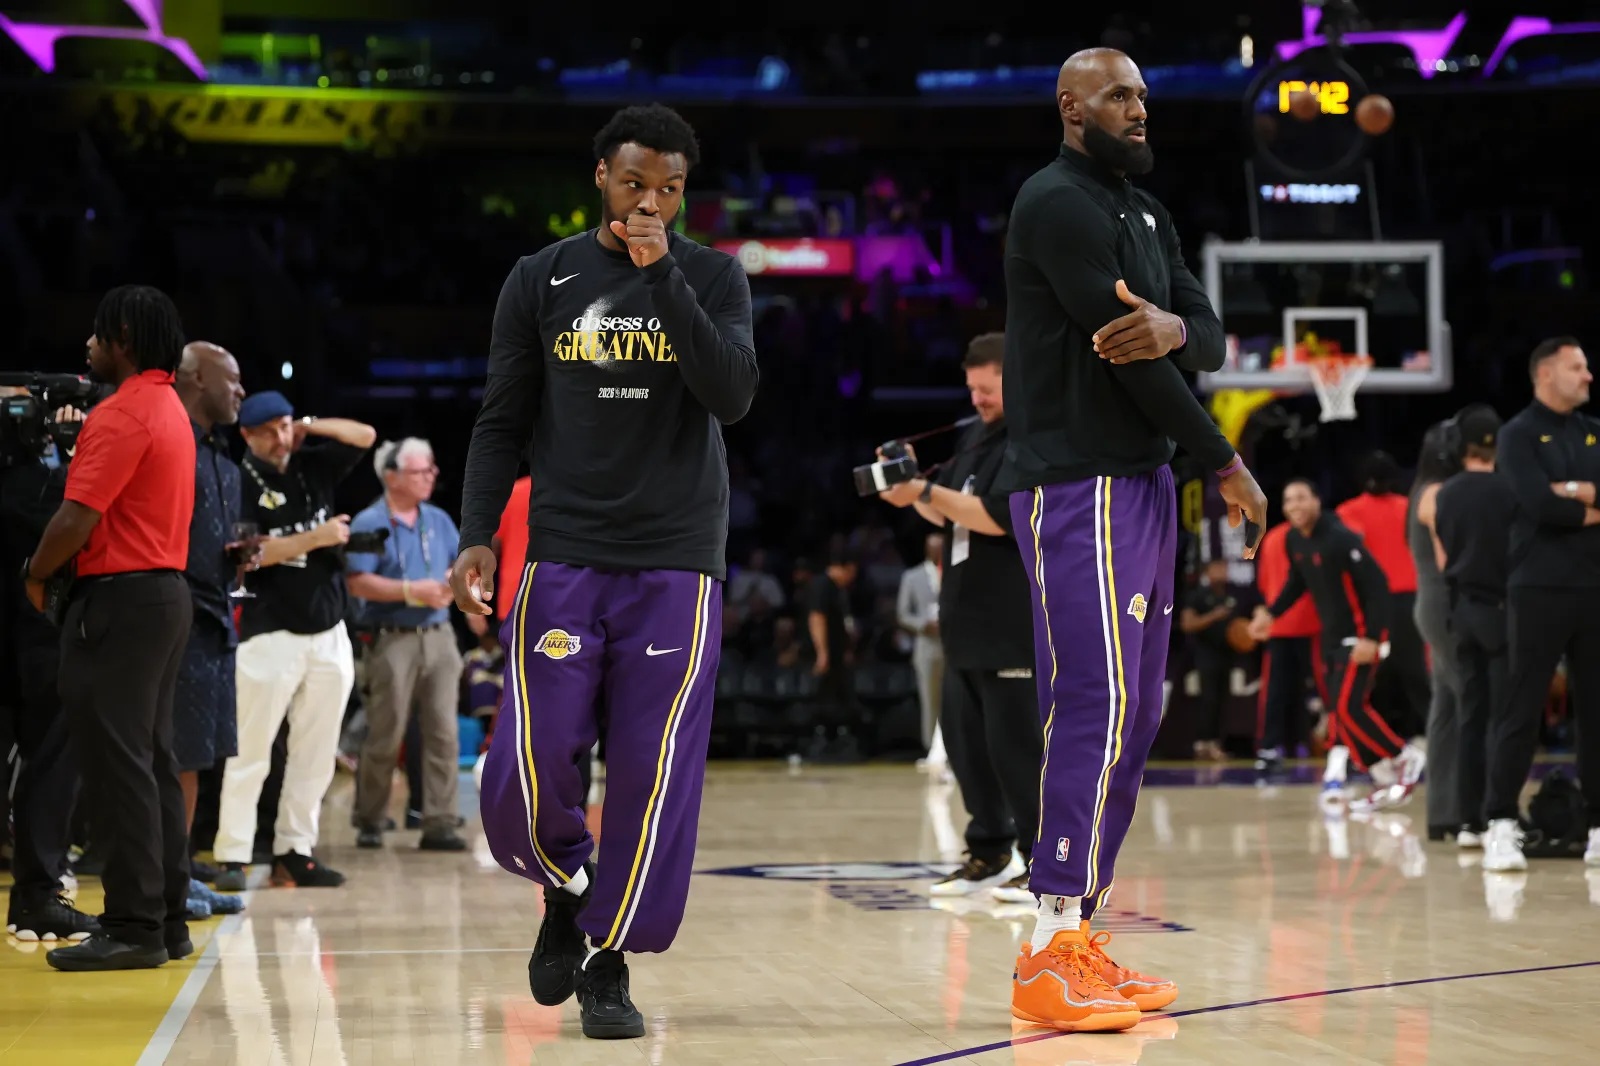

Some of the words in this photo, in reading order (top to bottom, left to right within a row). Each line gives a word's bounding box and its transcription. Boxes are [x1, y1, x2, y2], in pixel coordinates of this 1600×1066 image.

[1288, 184, 1360, 204] TISSOT
[572, 309, 643, 332] obsess
[556, 331, 678, 362] GREATNE
[598, 387, 615, 399] 2026
[620, 387, 649, 399] PLAYOFFS
[539, 636, 578, 653] LAKERS
